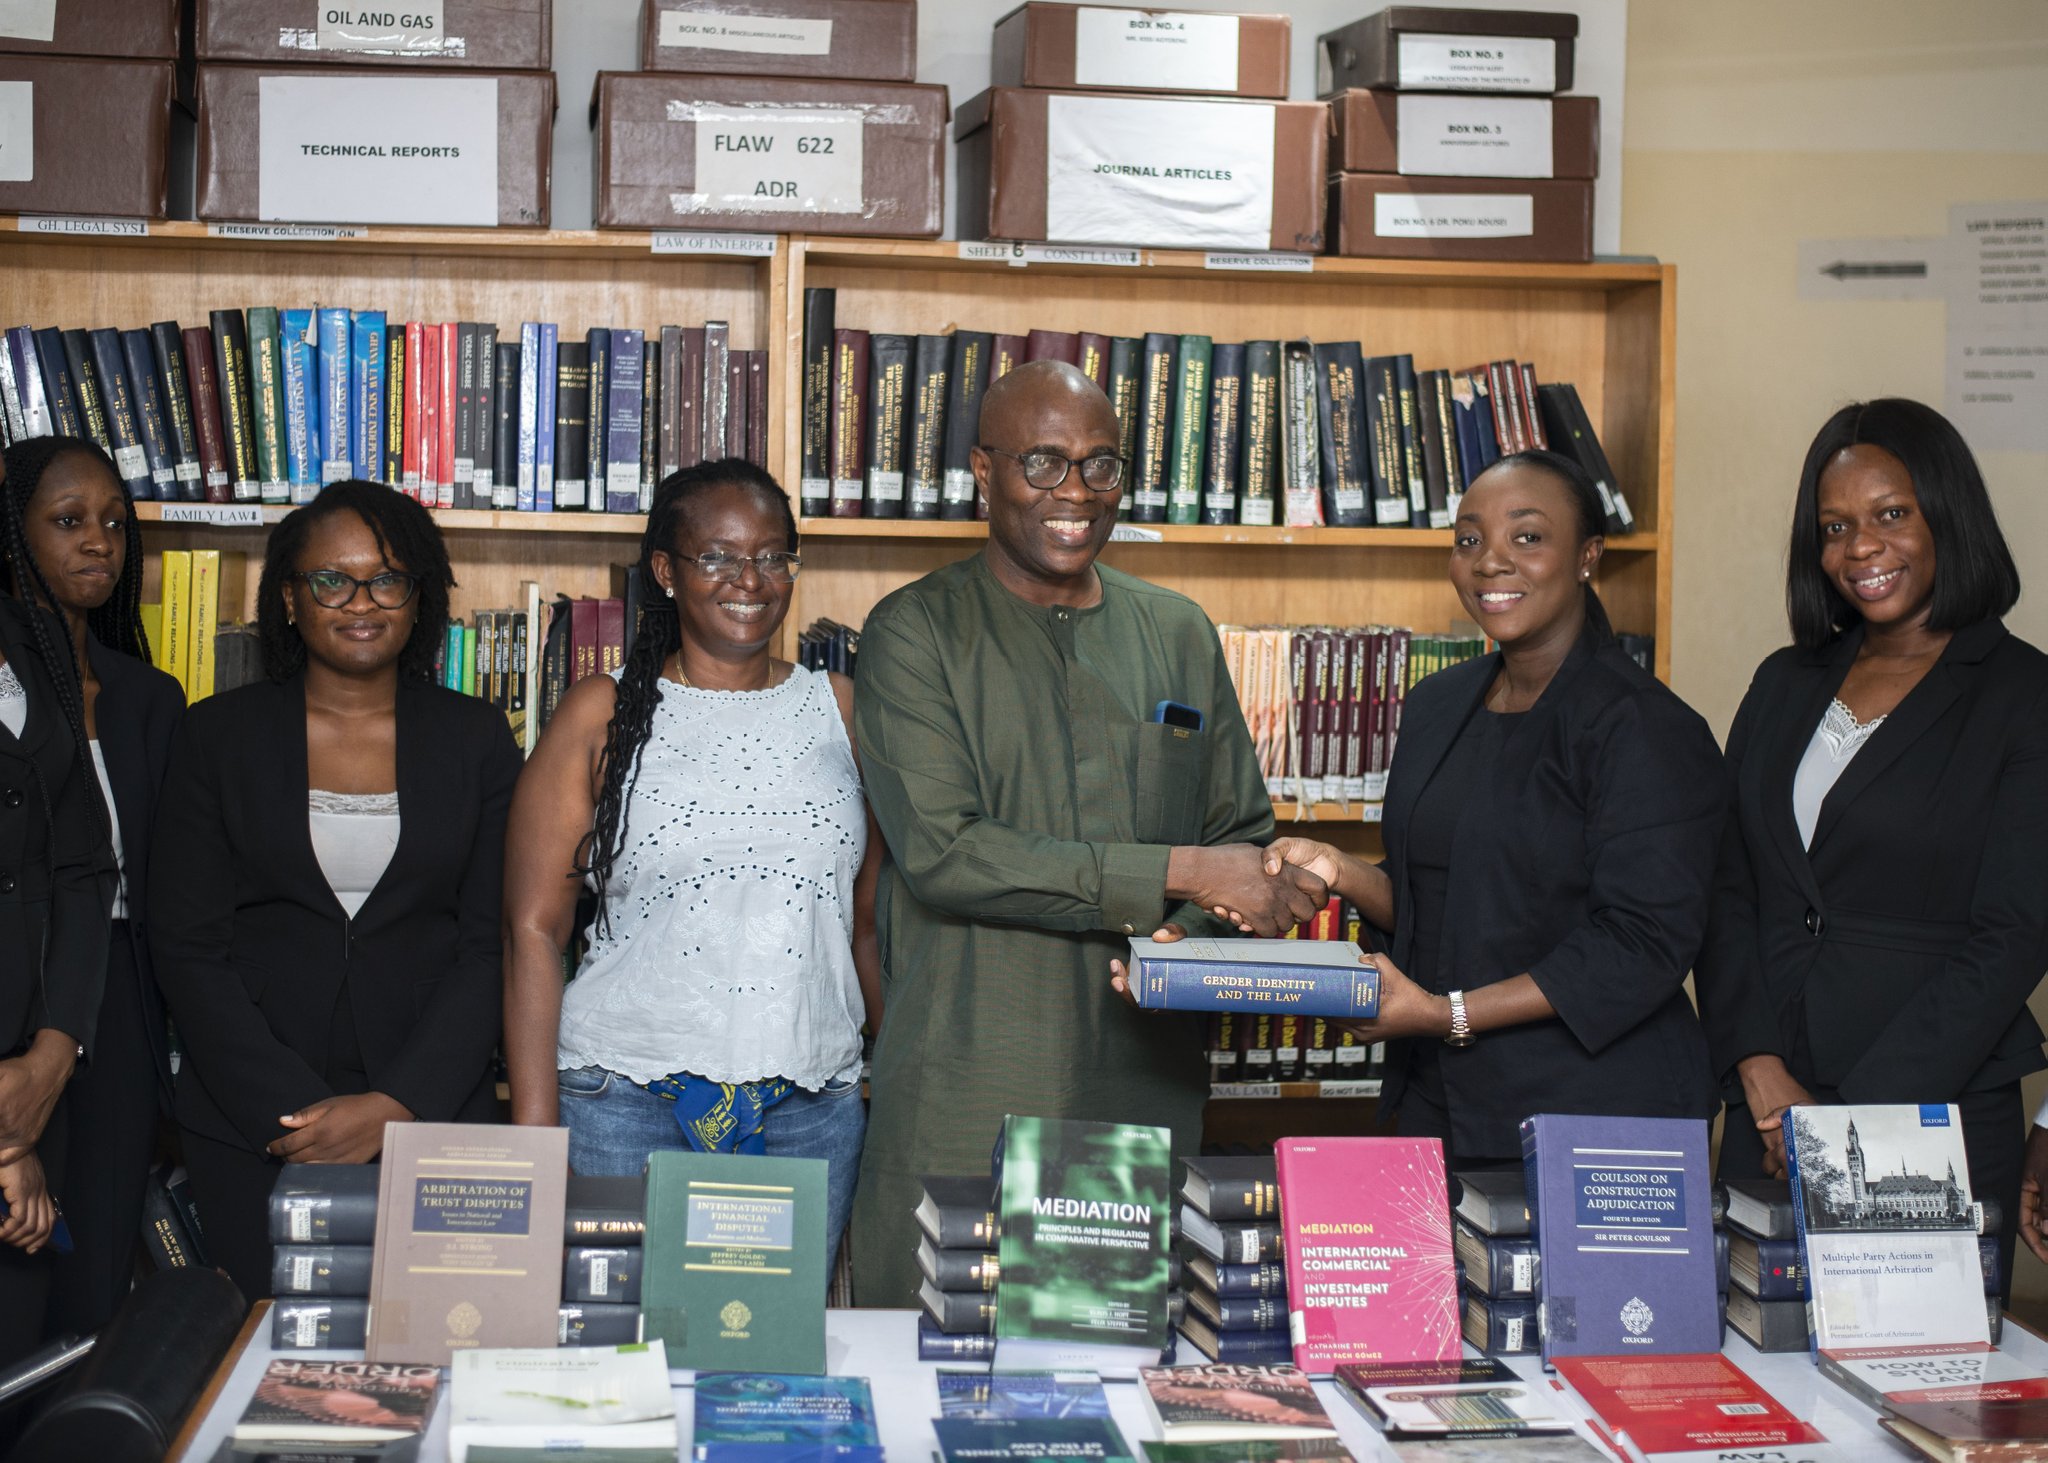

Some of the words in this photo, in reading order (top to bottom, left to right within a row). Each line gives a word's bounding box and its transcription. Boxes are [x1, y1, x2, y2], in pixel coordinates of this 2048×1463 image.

[326, 10, 354, 26] OIL
[357, 12, 395, 27] AND
[400, 14, 434, 30] GAS
[1129, 20, 1151, 29] BOX
[1450, 50, 1472, 58] BOX
[1448, 125, 1470, 133] BOX
[714, 135, 775, 153] FLAW
[797, 137, 834, 155] 622
[301, 144, 387, 159] TECHNICAL
[391, 145, 460, 159] REPORTS
[1094, 163, 1160, 179] JOURNAL
[1165, 167, 1232, 181] ARTICLES
[754, 180, 798, 198] ADR
[38, 220, 61, 231] GH.
[65, 221, 109, 233] LEGAL
[113, 222, 139, 233] SYS
[1393, 218, 1410, 226] BOX
[226, 226, 270, 235] RESERVE
[273, 227, 336, 237] COLLECTION
[655, 236, 680, 249] LAW
[683, 237, 699, 249] OF
[704, 238, 763, 252] INTERPR
[967, 246, 1007, 257] SHELF
[1012, 243, 1024, 257] 6
[1102, 252, 1130, 263] LAW
[1210, 257, 1250, 265] RESERVE
[1253, 258, 1311, 267] COLLECTION
[369, 332, 378, 364] GHANA
[337, 363, 346, 384] LAW
[369, 368, 378, 389] LAW
[464, 360, 472, 389] CRABBE
[368, 392, 377, 419] SINCE
[234, 427, 242, 443] AND
[164, 510, 216, 521] FAMILY
[220, 510, 251, 521] LAW
[1203, 975, 1253, 987] GENDER
[1256, 978, 1315, 990] IDENTITY
[1216, 990, 1242, 1000] AND
[1246, 991, 1271, 1001] THE
[1275, 993, 1301, 1002] LAW
[1244, 1086, 1270, 1096] LAW
[1122, 1131, 1152, 1139] OXFORD
[1591, 1172, 1647, 1183] COULSON
[1650, 1174, 1668, 1184] ON
[421, 1184, 507, 1196] ARBITRATION
[510, 1187, 527, 1197] OF
[1584, 1185, 1676, 1198] CONSTRUCTION
[421, 1197, 462, 1208] TRUST
[465, 1198, 524, 1209] DISPUTES
[697, 1201, 785, 1215] INTERNATIONAL
[1586, 1199, 1675, 1211] ADJUDICATION
[1032, 1197, 1151, 1224] MEDIATION
[711, 1212, 769, 1223] FINANCIAL
[575, 1221, 598, 1233] THE
[715, 1223, 765, 1233] DISPUTES
[1038, 1223, 1082, 1235] PRINCIPLES
[1083, 1226, 1100, 1236] AND
[1102, 1228, 1149, 1240] REGULATION
[1300, 1224, 1374, 1234] MEDIATION
[1035, 1233, 1044, 1242] IN
[1045, 1234, 1100, 1246] COMPARATIVE
[1101, 1237, 1149, 1250] PERSPECTIVE
[1634, 1235, 1670, 1243] COULSON
[1301, 1247, 1408, 1258] INTERNATIONAL
[1822, 1253, 1861, 1264] Multiple
[1863, 1252, 1886, 1263] Party
[1888, 1252, 1922, 1260] Actions
[1924, 1251, 1933, 1260] in
[1302, 1260, 1391, 1271] COMMERCIAL
[1823, 1266, 1882, 1276] International
[1883, 1265, 1933, 1275] Arbitration
[1304, 1283, 1389, 1295] INVESTMENT
[1305, 1297, 1368, 1308] DISPUTES
[720, 1330, 750, 1338] OXFORD
[270, 1362, 441, 1378] ORDER
[1143, 1364, 1305, 1379] ORDER
[1866, 1361, 1935, 1371] HOW
[1888, 1367, 1982, 1377] STUDY
[1919, 1374, 1982, 1384] LAW
[1925, 1389, 1974, 1398] Essential
[1976, 1388, 2010, 1396] Guide
[1734, 1436, 1788, 1444] Essential
[1719, 1452, 1785, 1461] LAW
